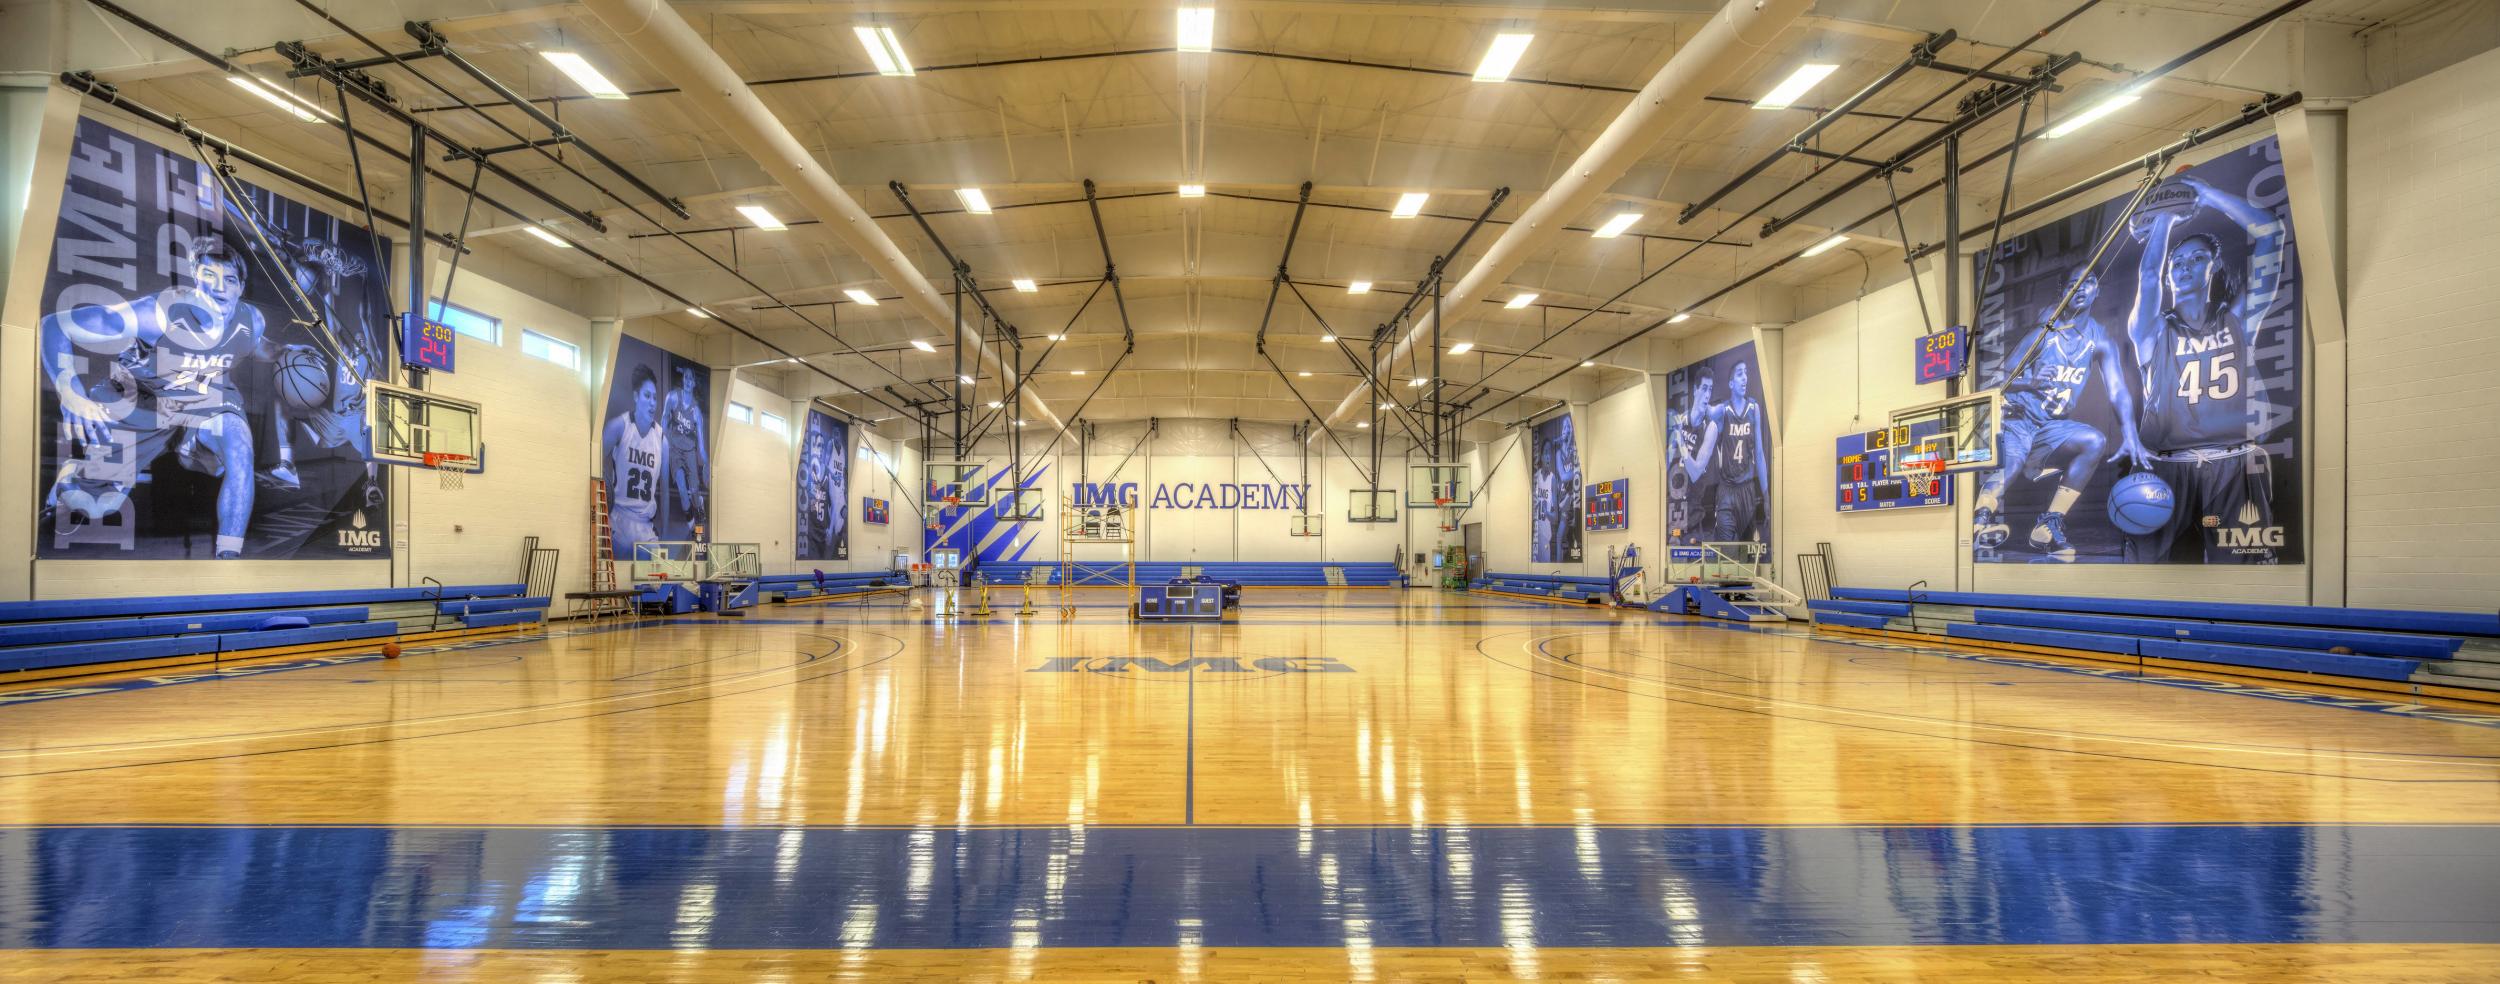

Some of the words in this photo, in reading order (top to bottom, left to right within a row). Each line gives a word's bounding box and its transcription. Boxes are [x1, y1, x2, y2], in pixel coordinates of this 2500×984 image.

[155, 152, 224, 437] MORE
[2246, 136, 2293, 475] POTENTIAL
[53, 117, 138, 551] BECOME
[423, 321, 452, 342] 2:00
[1926, 331, 1955, 352] 2:00
[2175, 327, 2235, 356] IMG
[181, 352, 234, 369] IMG
[420, 336, 447, 366] 24
[1923, 350, 1950, 378] 24
[2052, 365, 2087, 385] MG
[2177, 352, 2239, 405] 45
[1729, 422, 1751, 436] IMG
[628, 447, 655, 468] IMG
[1733, 439, 1744, 464] 4
[1842, 454, 1862, 464] HOME
[1853, 463, 1863, 481] 0
[626, 468, 653, 501] 23
[1073, 482, 1138, 508] IMG
[1150, 483, 1311, 509] ACADEMY
[338, 530, 381, 547] IMG
[2217, 527, 2284, 547] IMG
[695, 543, 707, 553] MG
[1025, 656, 1357, 673] IMG
